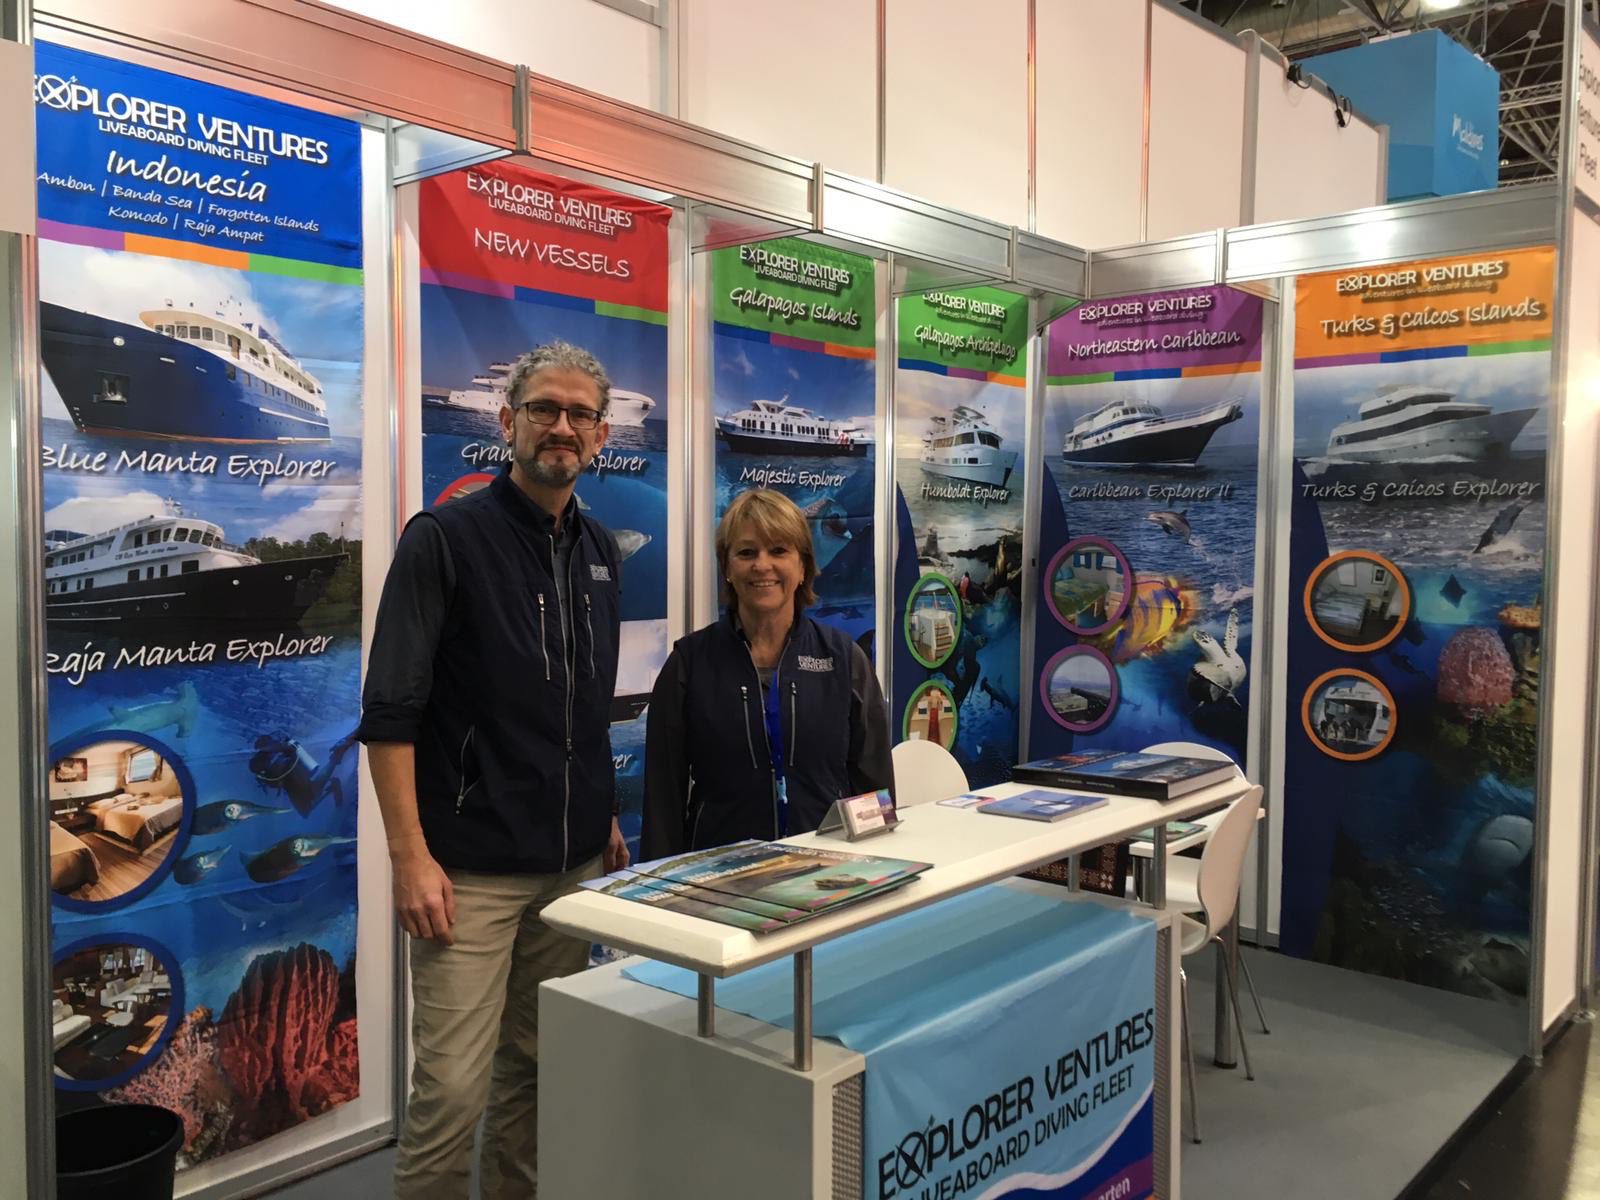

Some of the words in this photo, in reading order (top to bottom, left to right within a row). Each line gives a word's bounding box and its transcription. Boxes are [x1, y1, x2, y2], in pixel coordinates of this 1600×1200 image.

[98, 118, 185, 148] LIVEABOARD
[187, 138, 232, 159] DIVING
[233, 151, 269, 166] FLEET
[198, 112, 328, 164] VENTURES
[106, 150, 267, 203] Indonesia
[36, 171, 96, 193] Ambon
[112, 185, 163, 203] Banda
[165, 195, 192, 209] Sea
[207, 203, 271, 225] Forgotten
[273, 215, 320, 233] Islands
[467, 171, 554, 210] EXPLORER
[559, 195, 632, 229] VENTURES
[488, 196, 552, 222] LIVEABOARD
[554, 214, 587, 230] DIVING
[588, 221, 615, 236] FLEET
[108, 206, 168, 226] Komodo
[184, 218, 216, 237] Raja
[217, 227, 265, 243] Ampat
[474, 227, 530, 259] NEW
[532, 240, 630, 278] VESSELS
[739, 245, 799, 272] EXPLORER
[801, 260, 850, 284] VENTURES
[753, 265, 797, 282] LIVEABOARD
[797, 275, 821, 288] DIVING
[820, 280, 838, 292] FLEET
[1336, 270, 1417, 293] EXPLORER
[1422, 259, 1504, 283] VENTURES
[729, 287, 806, 320] Galapagos
[809, 301, 858, 326] Islands
[967, 298, 1006, 319] VENTURES
[1079, 302, 1144, 321] EXPLORER
[1147, 294, 1213, 313] VENTURES
[1319, 316, 1376, 335] Turks
[1379, 313, 1396, 335] &
[1399, 306, 1460, 329] Caicos
[1465, 297, 1542, 322] Islands
[914, 324, 965, 353] Galapagos
[965, 335, 1017, 362] Archipelago
[1067, 333, 1158, 358] Northeastern
[1161, 329, 1241, 351] Caribbean
[42, 444, 107, 473] Blue
[113, 450, 219, 475] Manta
[227, 453, 337, 488] Explorer
[461, 443, 514, 464] Gran
[589, 453, 648, 477] xplorer
[739, 464, 797, 490] Majestic
[798, 466, 847, 494] Explorer
[920, 481, 972, 500] Humboldt
[973, 484, 1010, 503] Explorer
[1068, 482, 1142, 499] Caribbean
[1146, 484, 1216, 503] Explorer
[1301, 481, 1358, 498] Turks
[1360, 483, 1379, 502] &
[1382, 478, 1446, 498] Caicos
[1452, 478, 1542, 503] Explorer
[113, 640, 218, 670] Manta
[225, 632, 336, 669] Explorer
[878, 1076, 1035, 1200] EXPLORER
[1044, 1007, 1155, 1102] VENTURES
[912, 1129, 1031, 1200] VEABOARD
[1034, 1093, 1090, 1147] DIVING
[1092, 1064, 1134, 1110] FLEET
